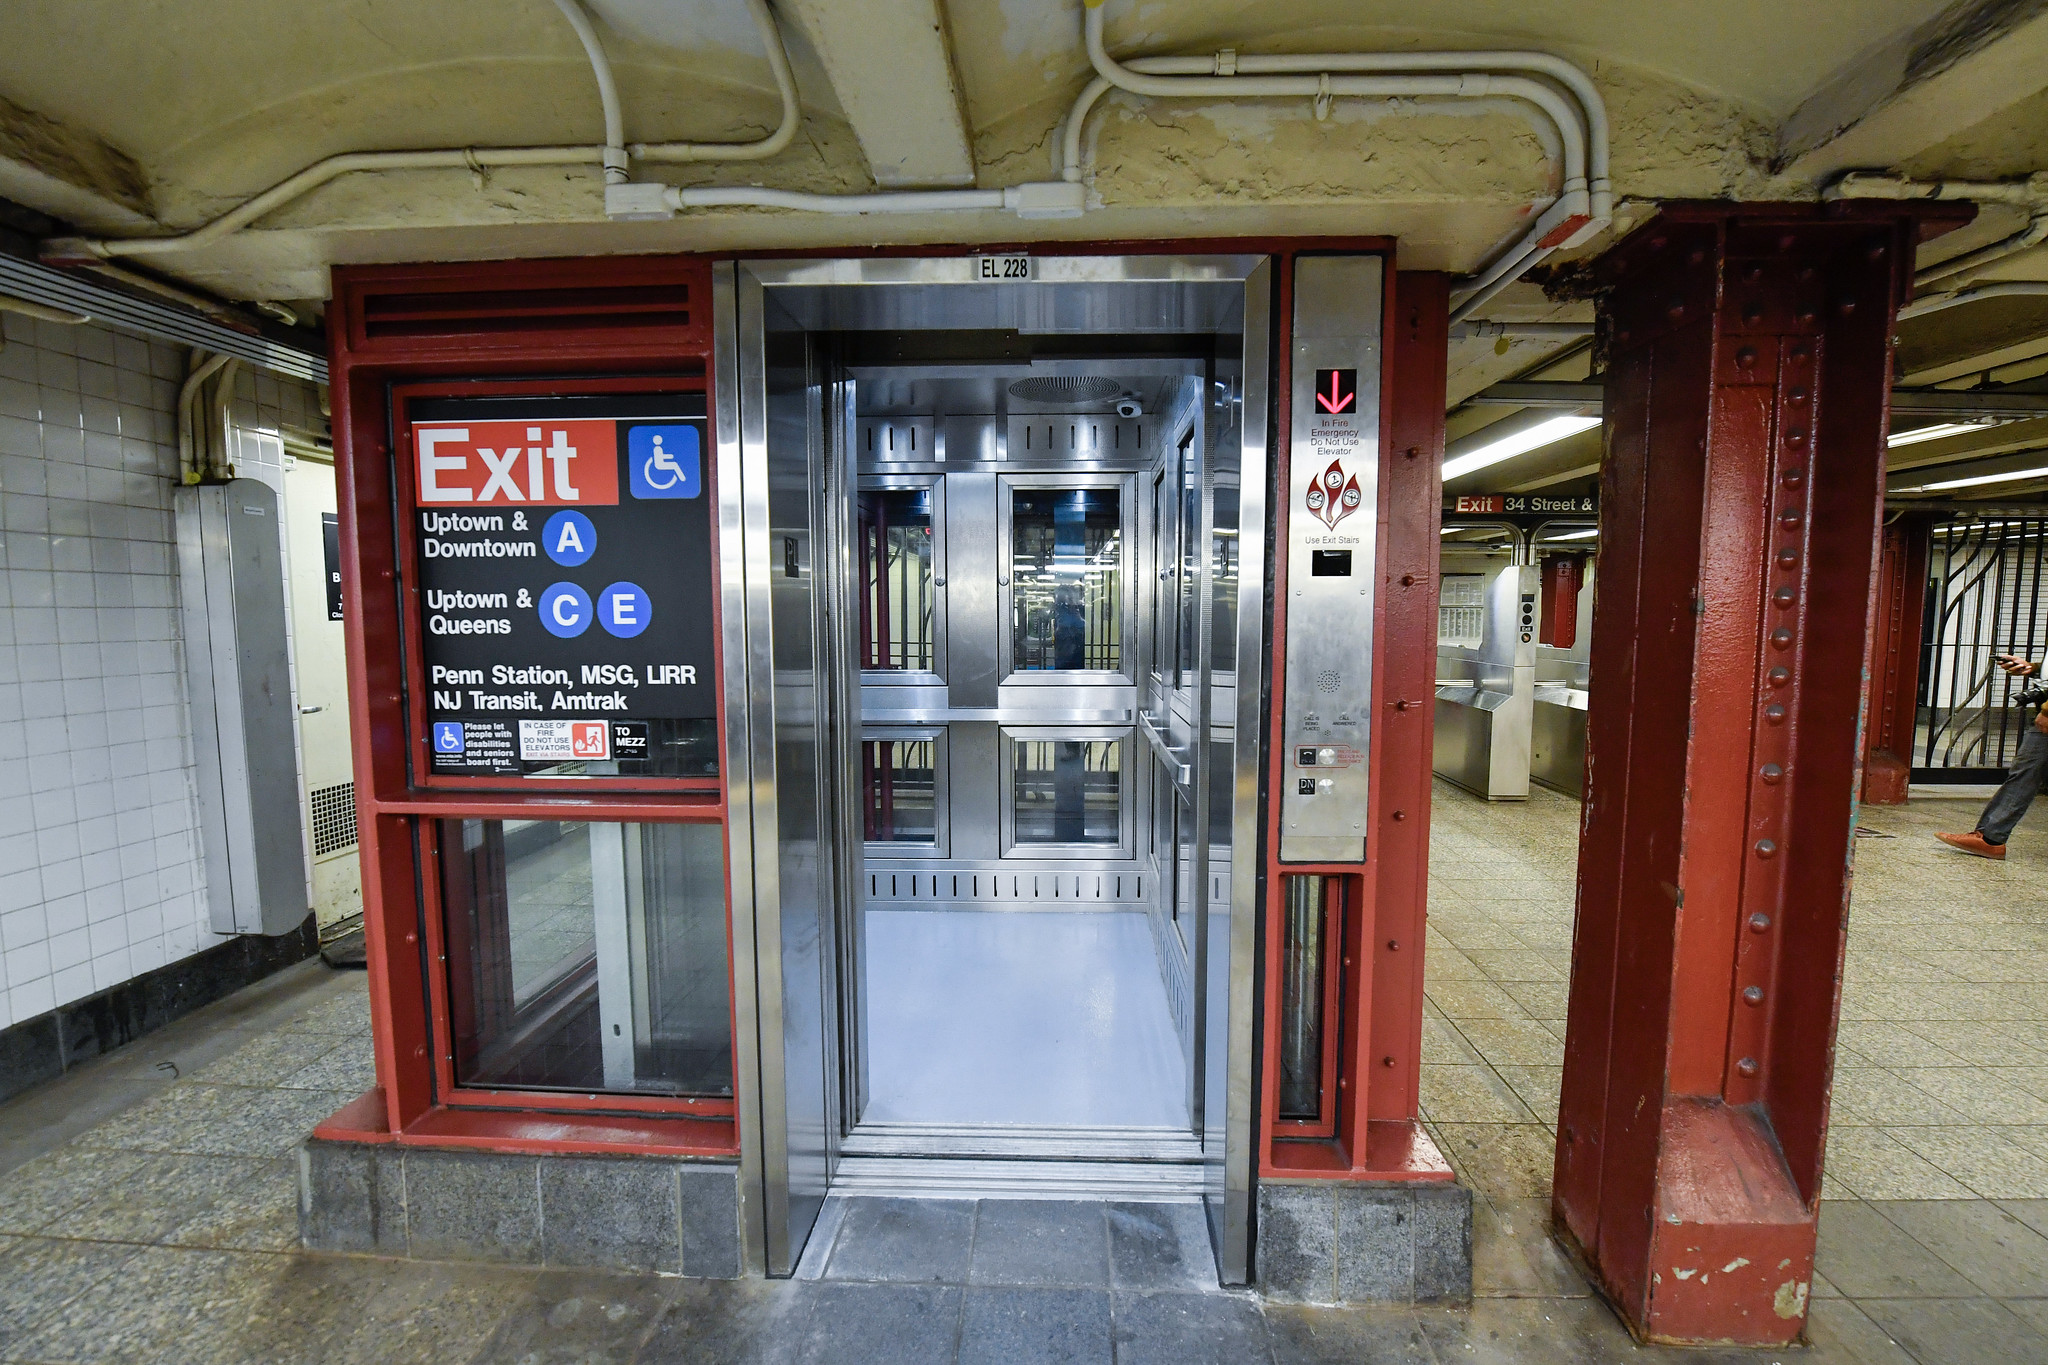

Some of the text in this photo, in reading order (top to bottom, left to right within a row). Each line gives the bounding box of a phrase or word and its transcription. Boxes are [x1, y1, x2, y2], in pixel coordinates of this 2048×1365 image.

[982, 258, 1028, 278] EL 228
[1321, 419, 1349, 427] In Fire
[1311, 428, 1359, 438] Emergency
[1310, 438, 1360, 446] Do Not Use
[1317, 447, 1352, 455] Elevator
[417, 427, 579, 502] Exit
[1457, 496, 1593, 512] Exit 34 Street &
[422, 510, 529, 536] Uptown &
[556, 522, 584, 553] A
[1305, 535, 1360, 544] Use Exit Stairs
[424, 538, 537, 558] Downtown
[427, 588, 533, 613] Uptown &
[552, 593, 637, 627] C E
[429, 614, 512, 635] Queens
[432, 664, 697, 690] Penn Station, MSG, LIRR
[433, 690, 629, 712] NJ Transit, Amtrak
[493, 722, 505, 730] let
[615, 726, 631, 736] TO
[465, 731, 493, 739] people
[465, 740, 511, 748] disabilities
[616, 737, 646, 747] MEZZ
[466, 749, 515, 757] and seniors
[467, 758, 491, 766] board
[492, 758, 512, 766] first.
[1300, 779, 1315, 789] DN
